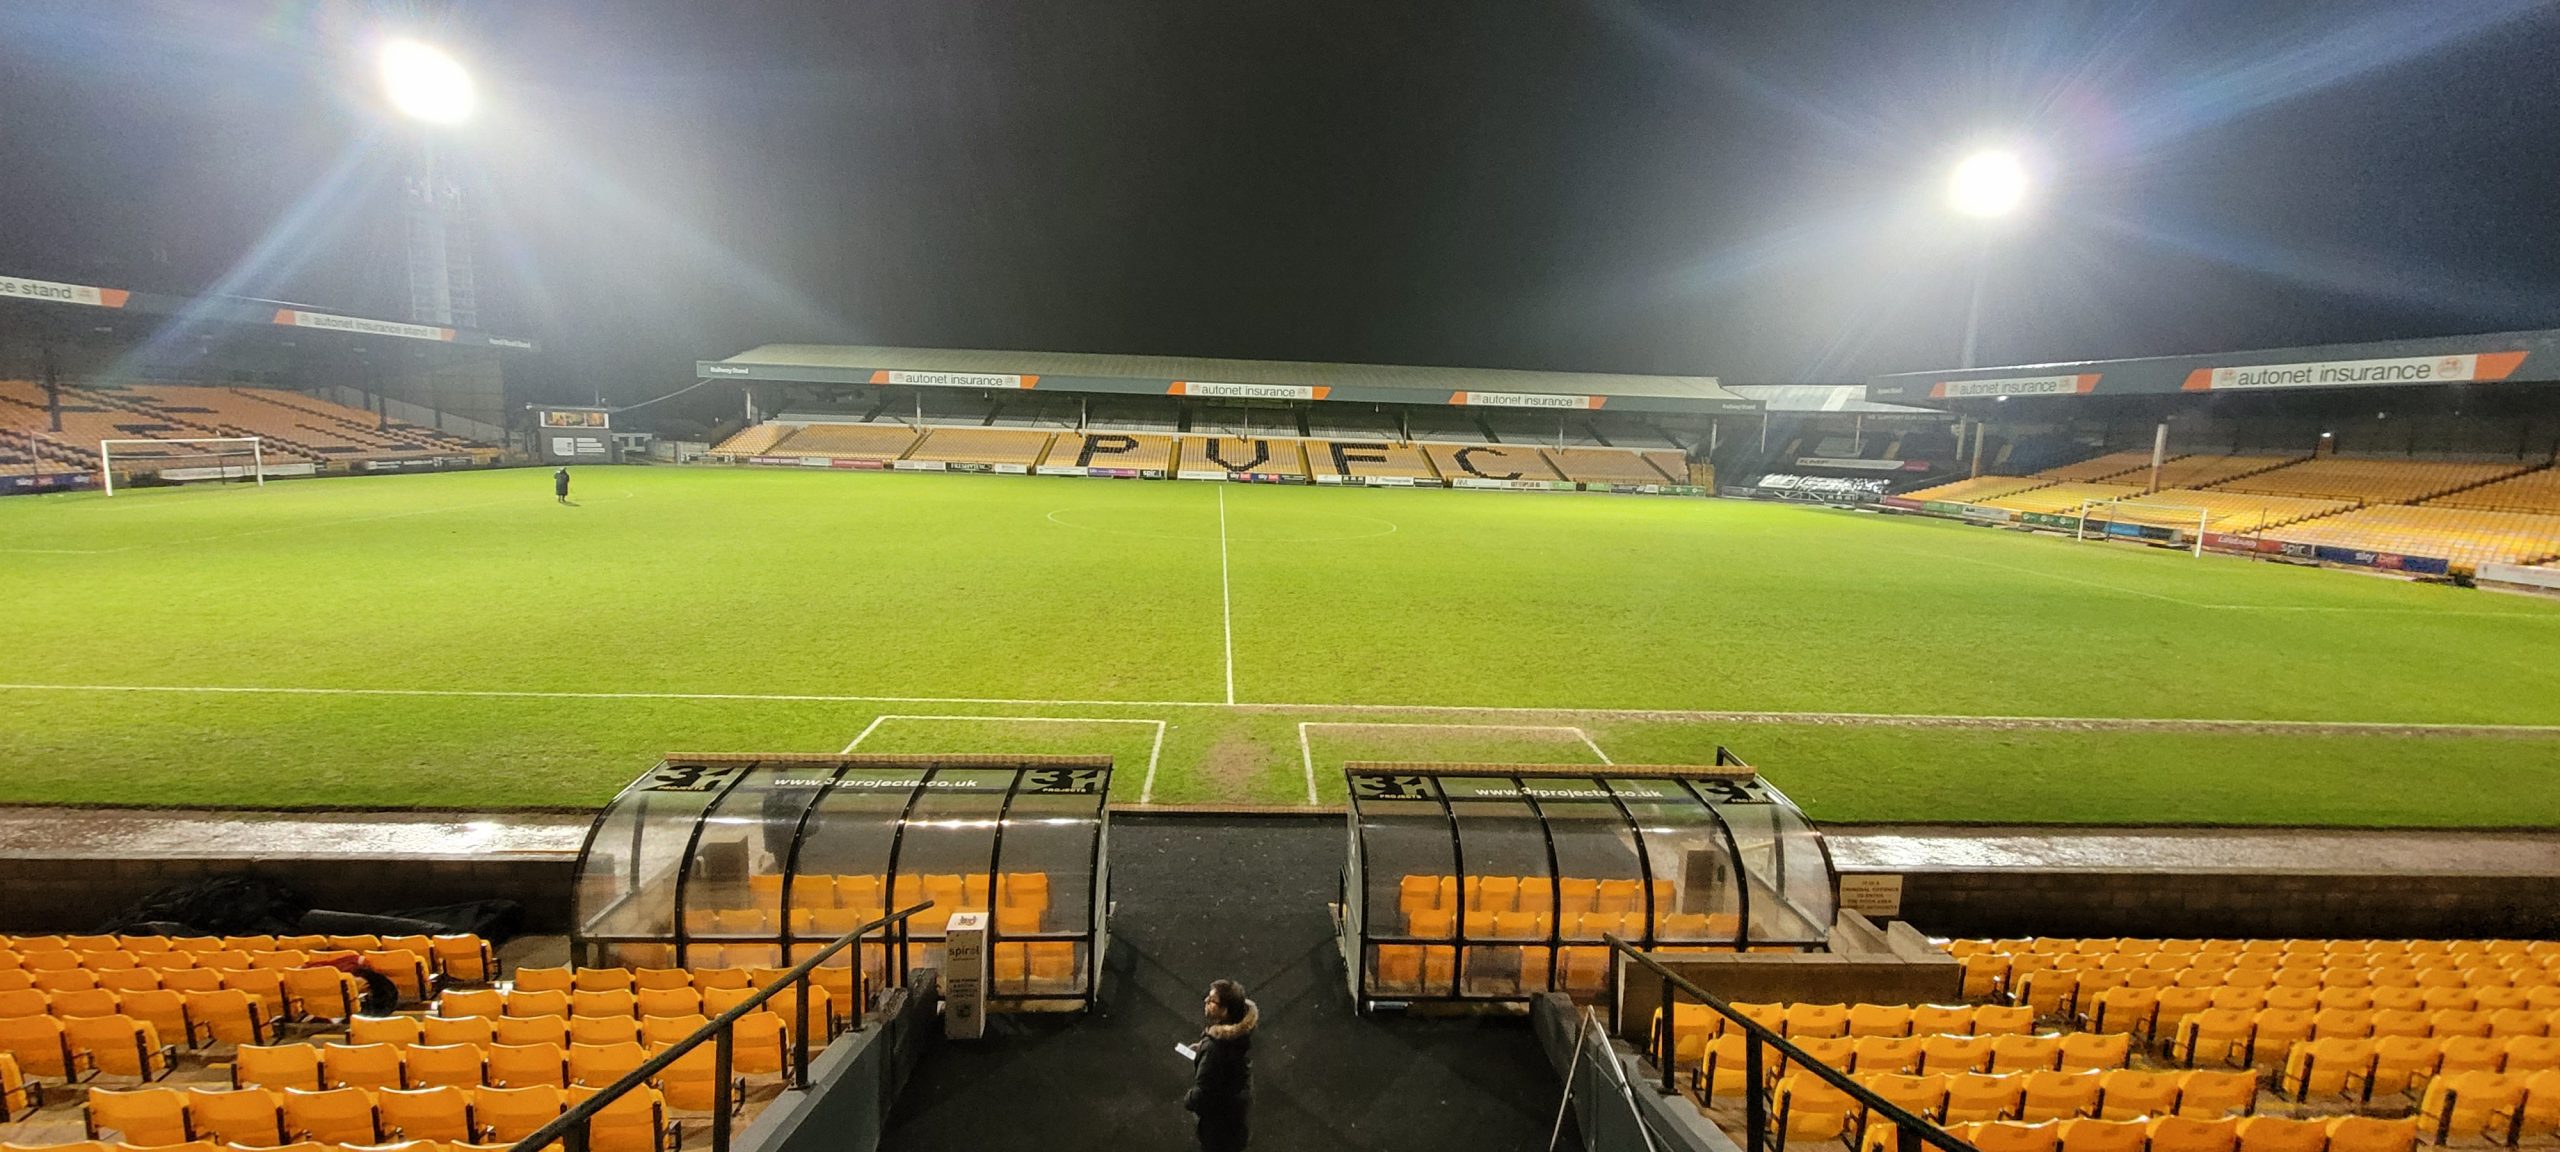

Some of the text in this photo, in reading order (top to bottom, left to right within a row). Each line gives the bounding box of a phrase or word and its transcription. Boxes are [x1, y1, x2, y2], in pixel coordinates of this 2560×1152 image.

[21, 283, 73, 299] stand
[314, 315, 353, 328] autonet
[905, 373, 1003, 386] autonet insurance
[2238, 363, 2431, 386] autonet insurance
[1202, 385, 1296, 397] autonet insurance
[1960, 380, 2057, 395] autonet insurance
[1482, 395, 1573, 407] autonet insurance
[2355, 552, 2377, 564] sky
[774, 777, 978, 789] www.3rprojects.co.uk
[1475, 787, 1664, 799] www.3rprojects.co.uk
